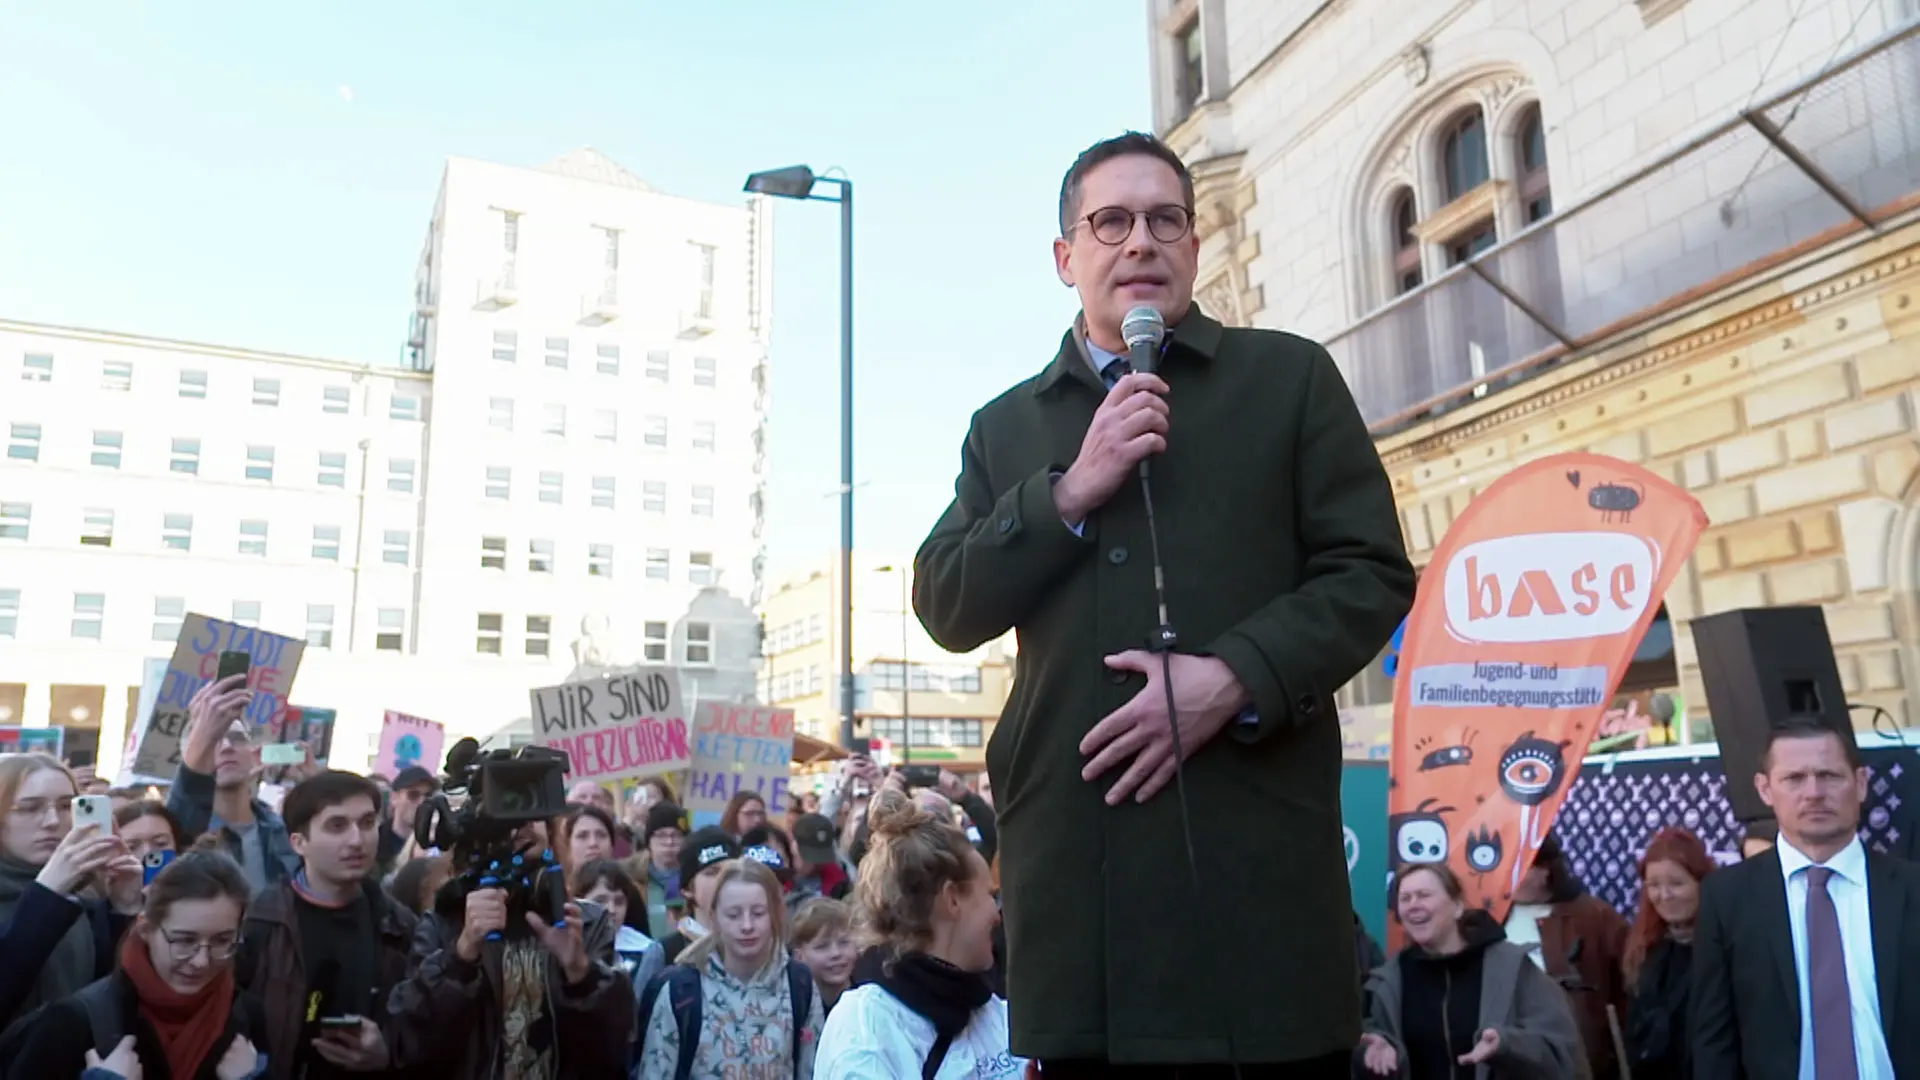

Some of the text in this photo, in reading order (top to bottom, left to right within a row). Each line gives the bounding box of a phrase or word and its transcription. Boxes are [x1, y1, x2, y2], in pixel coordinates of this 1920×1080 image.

[1464, 555, 1637, 622] base
[1472, 661, 1558, 683] Jugend- und
